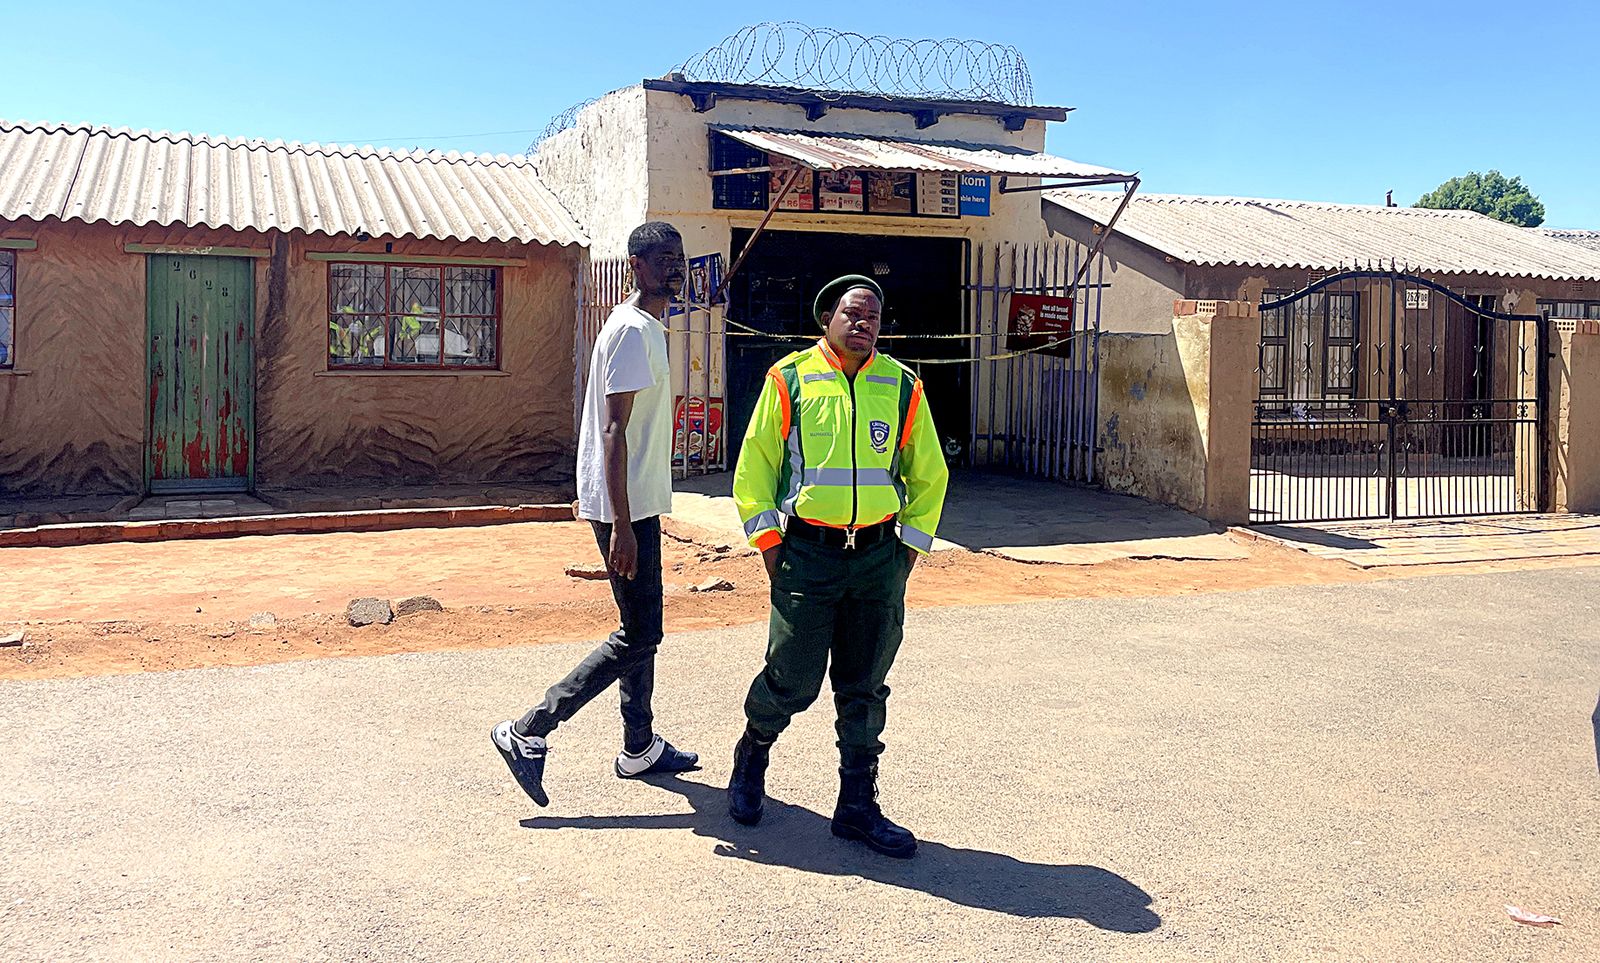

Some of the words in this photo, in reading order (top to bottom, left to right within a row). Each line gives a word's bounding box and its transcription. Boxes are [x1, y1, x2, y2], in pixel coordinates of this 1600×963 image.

[961, 174, 986, 187] kom
[786, 199, 799, 208] R6
[972, 195, 985, 203] here
